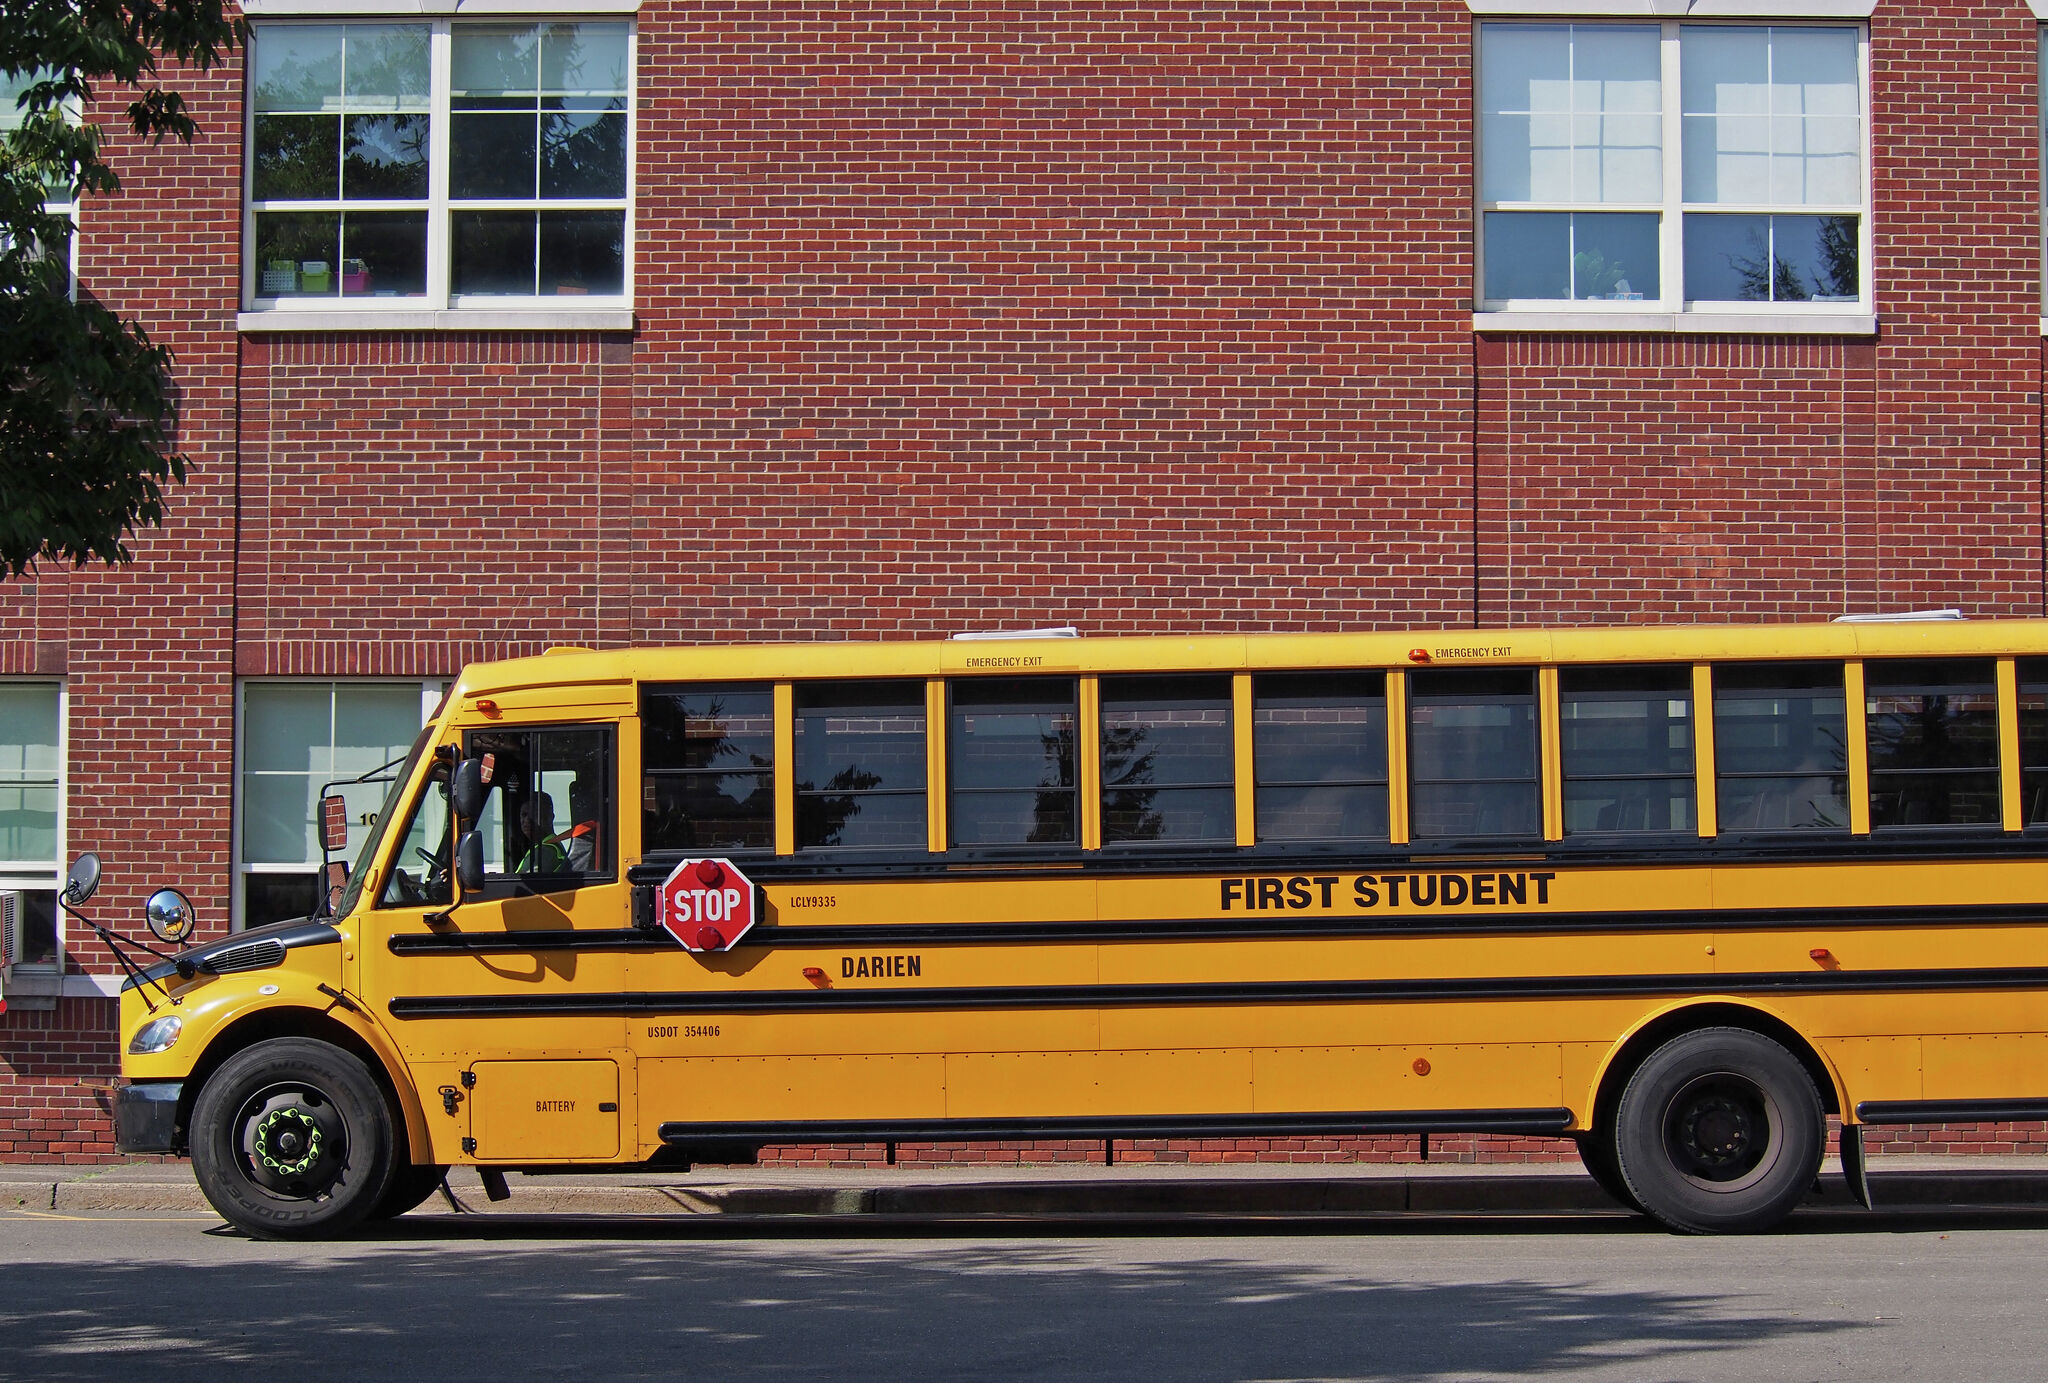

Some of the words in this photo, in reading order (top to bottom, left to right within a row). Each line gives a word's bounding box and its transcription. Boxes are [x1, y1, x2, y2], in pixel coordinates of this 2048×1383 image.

[1435, 648, 1490, 658] EMERGENCY
[1493, 647, 1512, 657] EXIT
[966, 657, 1021, 667] EMERGENCY
[1023, 656, 1043, 666] EXIT
[1221, 876, 1339, 911] FIRST
[1353, 872, 1556, 908] STUDENT
[674, 888, 741, 922] STOP
[791, 896, 836, 908] LCLY9335
[841, 955, 921, 978] DARIEN
[647, 1026, 678, 1038] USDOT
[684, 1025, 720, 1037] 354406
[536, 1100, 576, 1112] BATTERY
[217, 1168, 308, 1221] COOPER
